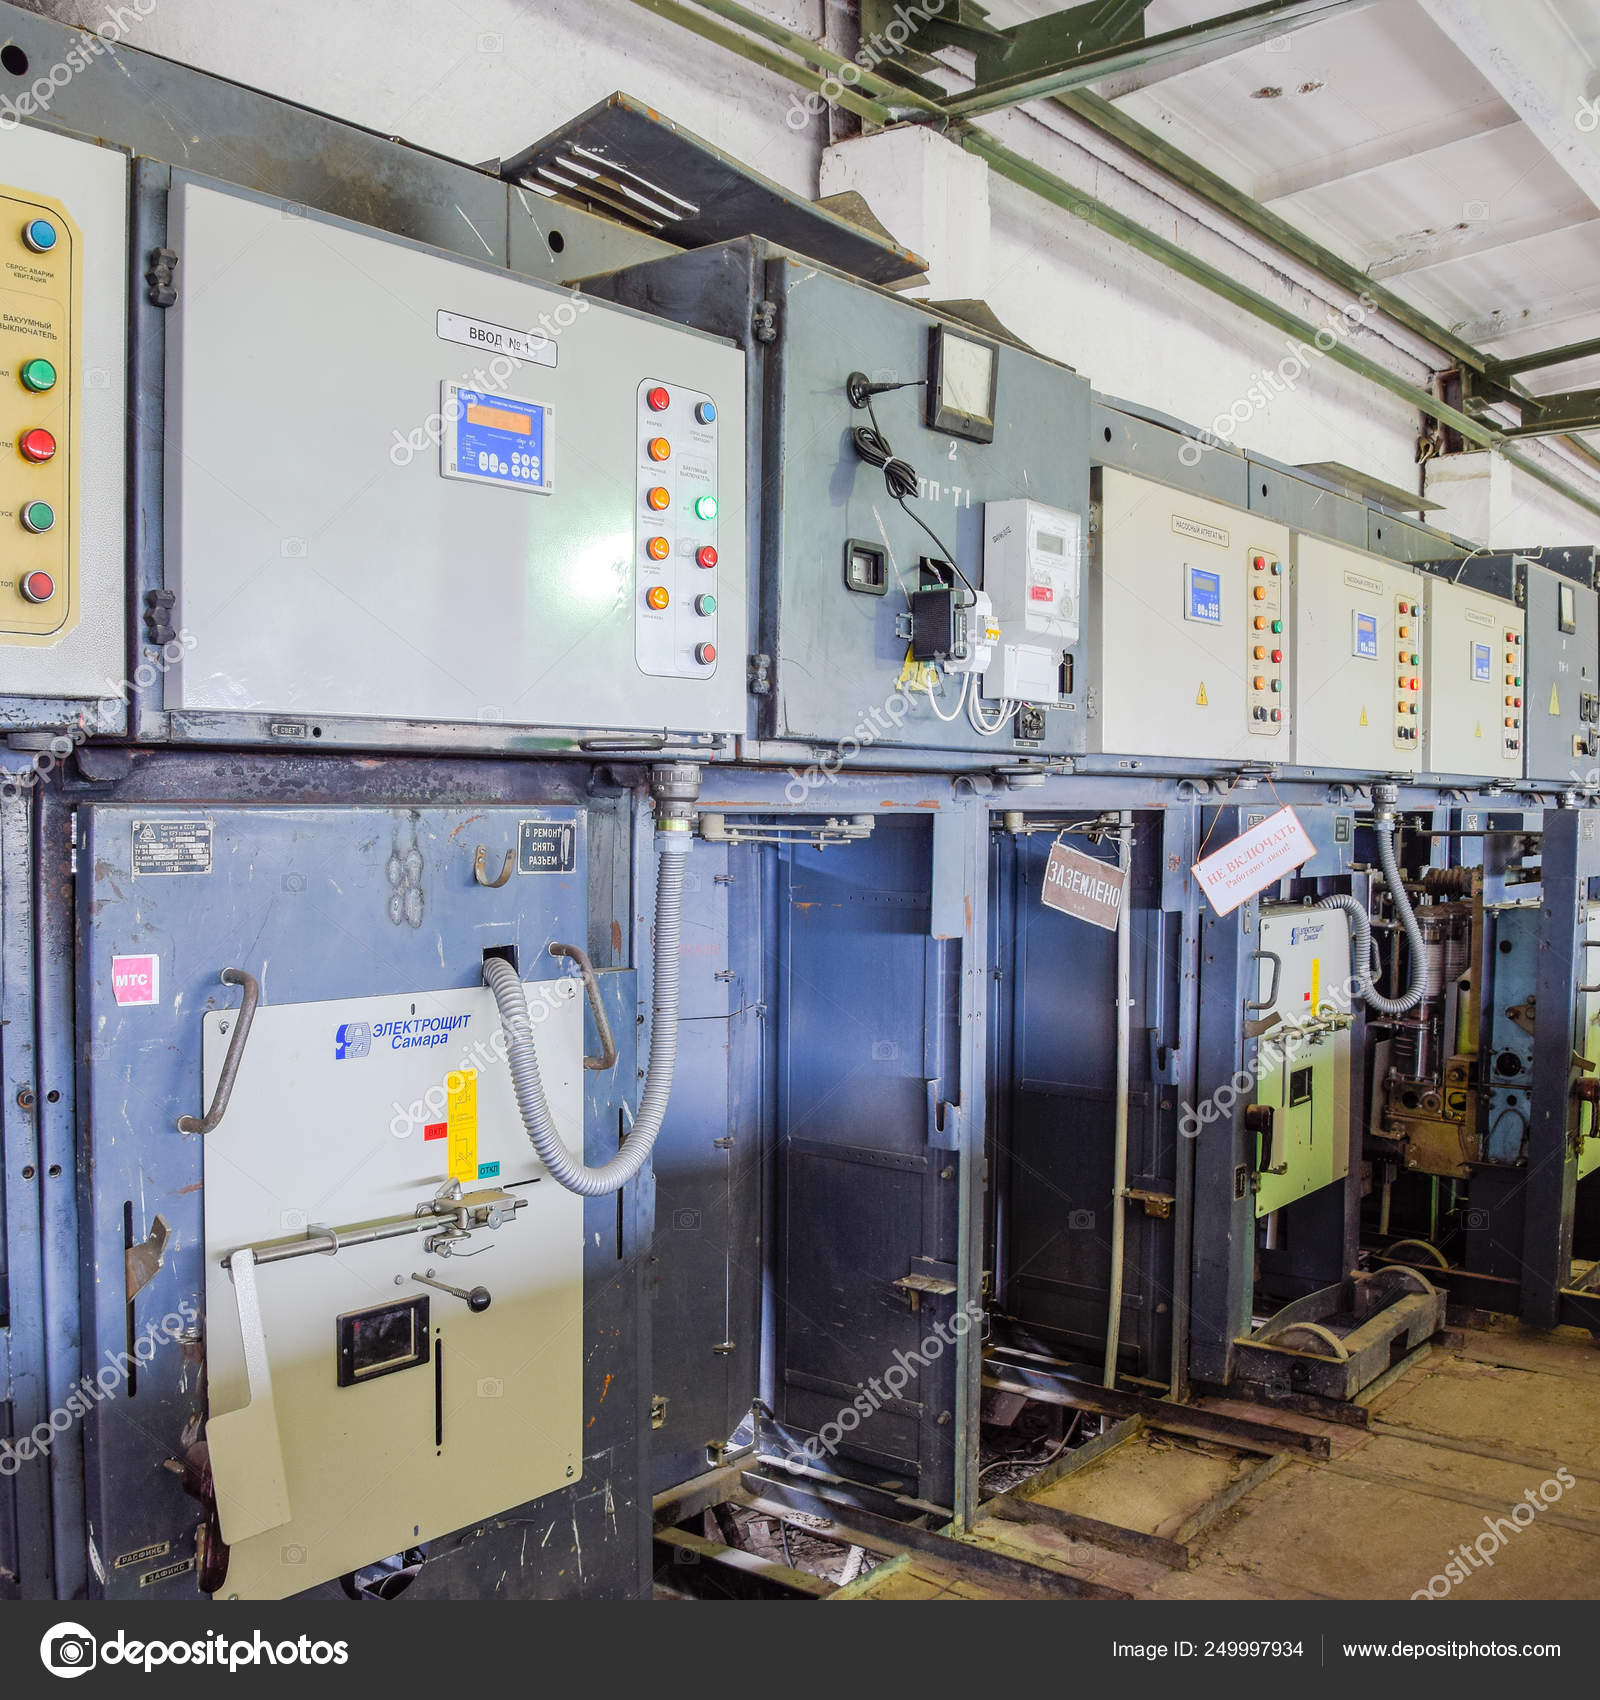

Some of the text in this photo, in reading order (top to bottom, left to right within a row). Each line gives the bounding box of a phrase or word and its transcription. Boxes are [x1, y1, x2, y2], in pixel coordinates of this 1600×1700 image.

[5, 262, 54, 279] СБРОС АВАРИИ
[13, 271, 47, 284] КВИТАЦИЯ
[3, 313, 52, 330] ВАКУУМНЫЙ
[470, 327, 503, 348] ВВОД
[0, 440, 13, 449] ТКЛ
[948, 440, 958, 461] 2
[525, 828, 561, 838] В РЕМОНТ
[532, 842, 555, 852] СНЯТЬ
[1207, 867, 1226, 886] НЕ
[1225, 824, 1297, 874] ВКЛЮЧАТЬ
[529, 856, 557, 866] РАЗЪЕМ
[1225, 861, 1265, 888] Работают
[1048, 860, 1120, 908] ЗАЗЕМЛЕНО
[115, 974, 148, 987] МТС
[372, 1014, 472, 1038] ЭЛЕКТРОЩИТ
[391, 1033, 449, 1050] Самара
[428, 1127, 443, 1137] ВКЛ
[480, 1165, 498, 1175] ОТКЛ
[122, 1546, 163, 1563] РАСФИКС
[148, 1564, 185, 1581] ЗАФИКС
